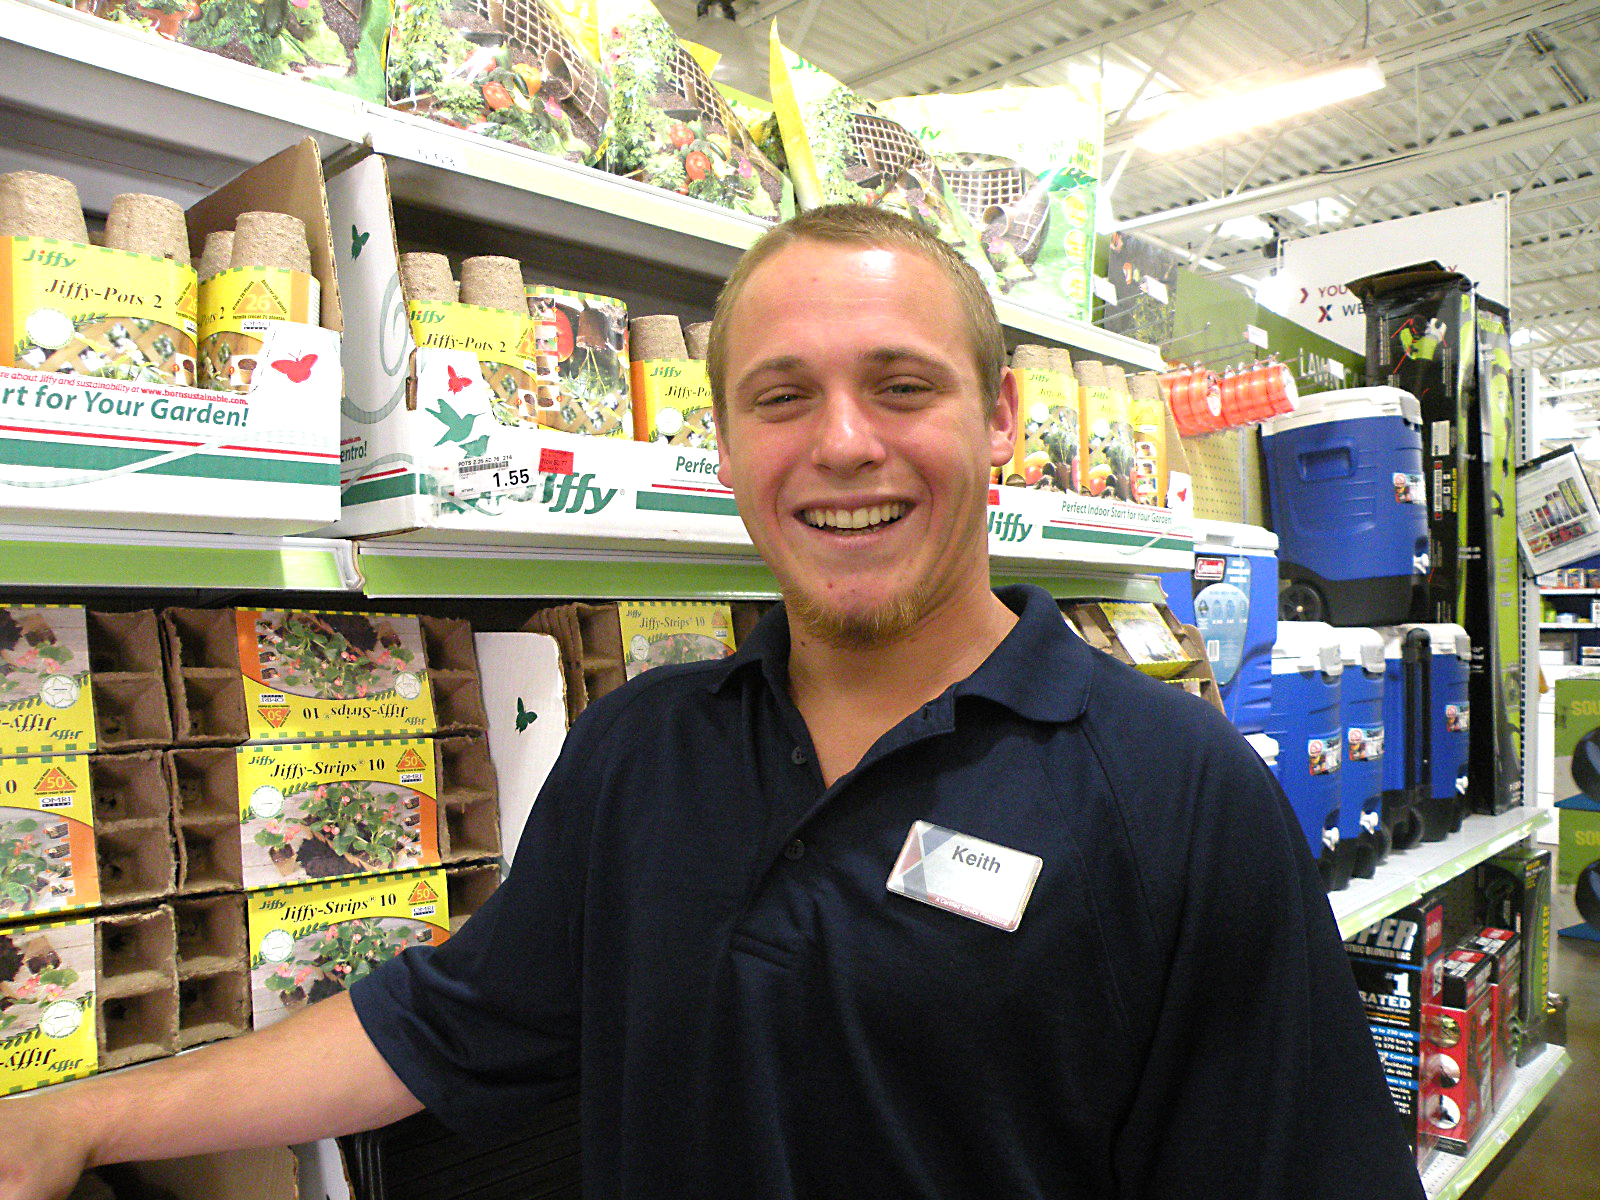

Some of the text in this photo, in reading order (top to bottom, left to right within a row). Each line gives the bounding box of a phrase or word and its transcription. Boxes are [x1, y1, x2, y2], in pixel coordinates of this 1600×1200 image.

[22, 249, 76, 267] Jiffy
[45, 279, 143, 305] Jiffy-Pots
[153, 294, 163, 308] 2
[1318, 285, 1349, 298] YOU
[245, 294, 271, 312] 26
[410, 310, 445, 323] Jiffy
[423, 333, 507, 353] Jiffy-Pots 2
[650, 367, 682, 378] Jiffy
[11, 372, 38, 382] about
[39, 374, 57, 386] Jiffy
[58, 378, 76, 387] and
[76, 380, 130, 393] sustainability
[665, 385, 711, 399] Jiffy-Po
[35, 384, 77, 410] for
[84, 390, 145, 416] Your
[150, 398, 249, 428] Garden!
[676, 455, 720, 476] Perfec
[492, 468, 530, 488] 1.55
[1061, 500, 1087, 514] Perfect
[1087, 503, 1110, 517] Indoor
[1111, 507, 1126, 519] Start
[1127, 508, 1137, 520] for
[1137, 511, 1151, 522] Your
[988, 511, 1033, 542] Jiffy
[640, 616, 705, 630] Jiffy-Strips 10
[50, 728, 84, 741] Jiffy
[248, 755, 276, 766] Jiffy
[404, 756, 418, 767] 50
[270, 757, 385, 780] Jiffy-Strips 10
[46, 776, 66, 789] 50
[41, 796, 71, 804] OMRI
[952, 845, 1001, 874] Keith
[416, 888, 430, 900] 50
[258, 899, 287, 910] Jiffy
[280, 892, 397, 923] Jiffy-Strips 10
[48, 1058, 84, 1073] Jiffy
[1389, 1053, 1413, 1063] Control
